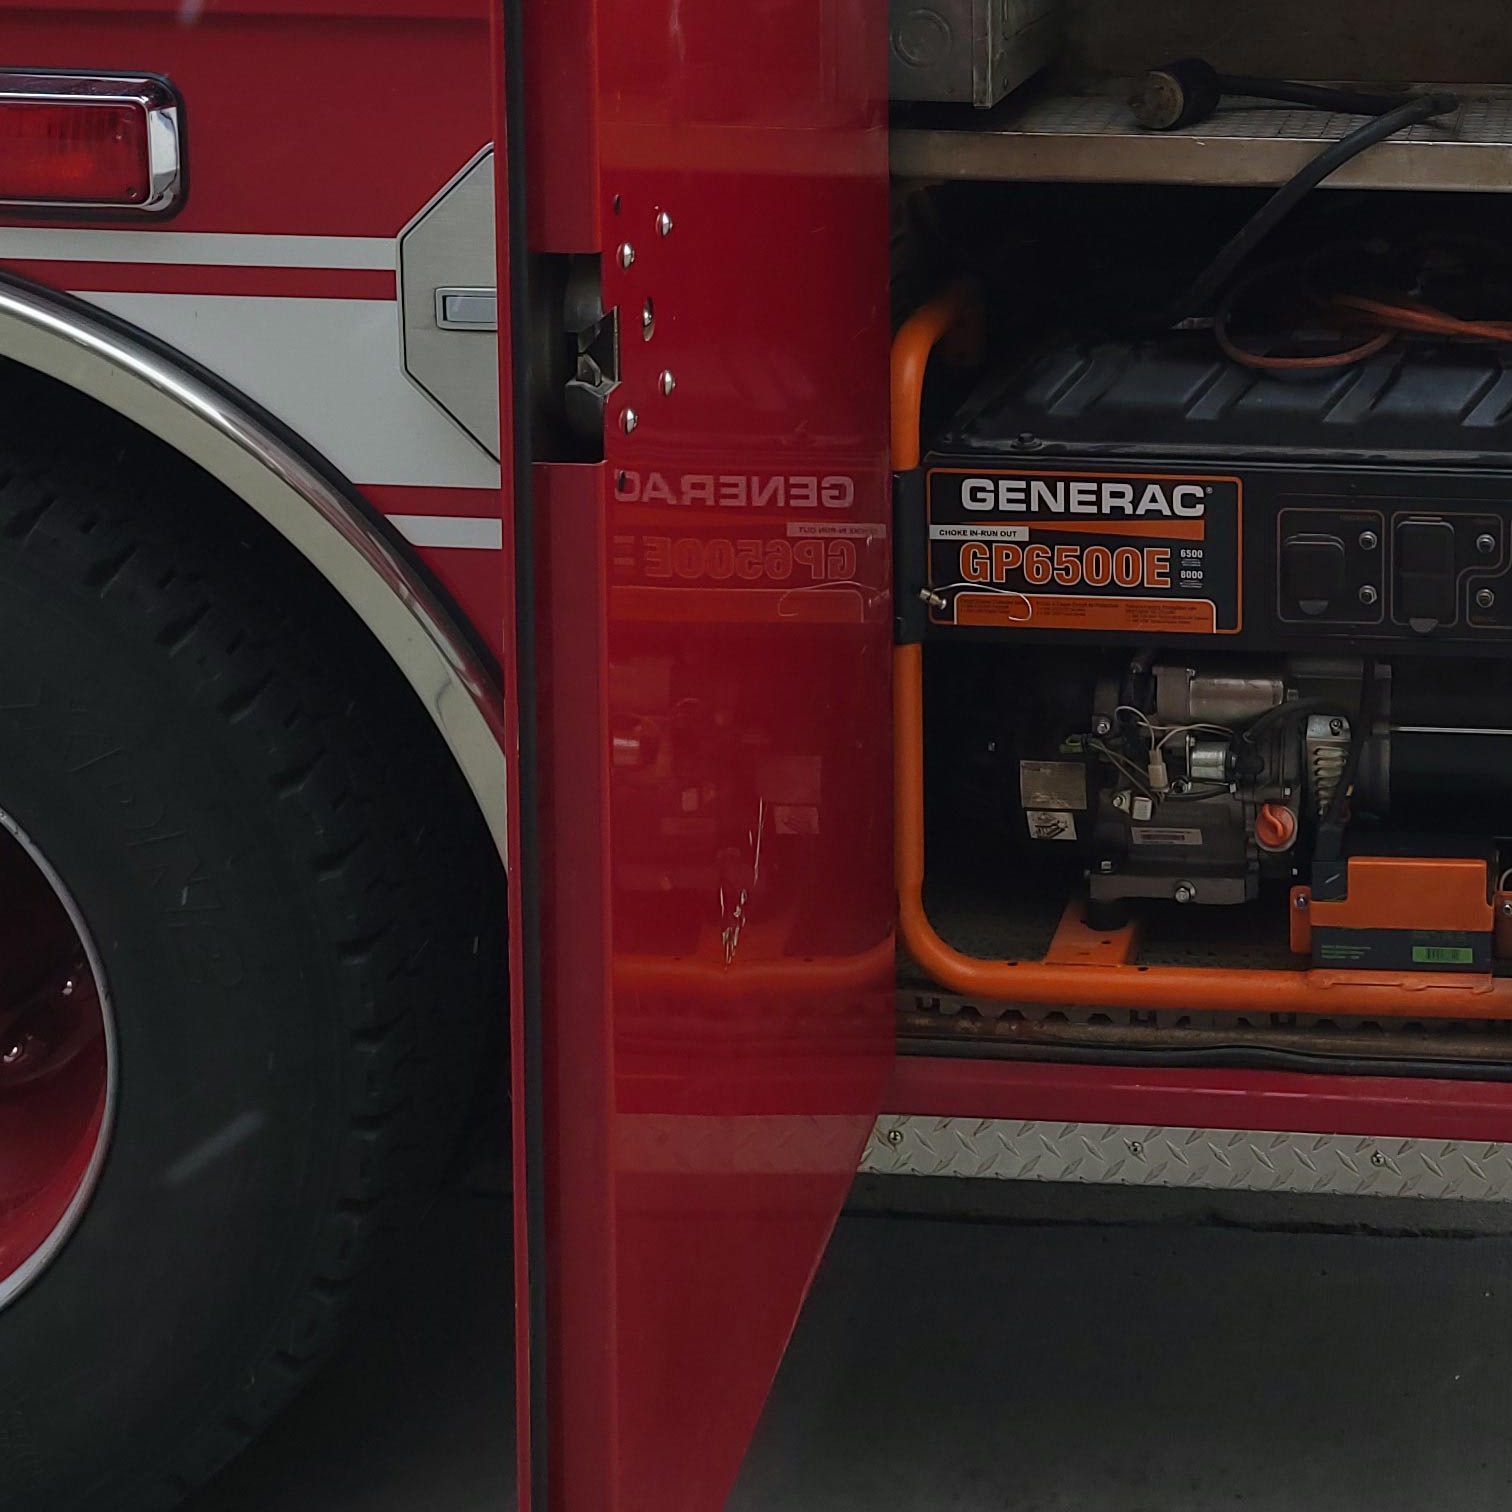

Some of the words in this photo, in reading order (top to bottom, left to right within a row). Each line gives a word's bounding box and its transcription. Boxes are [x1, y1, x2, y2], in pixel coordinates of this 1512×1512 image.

[961, 478, 1205, 516] GENERAC
[959, 542, 1171, 588] GP6500E
[1180, 549, 1203, 558] 6500
